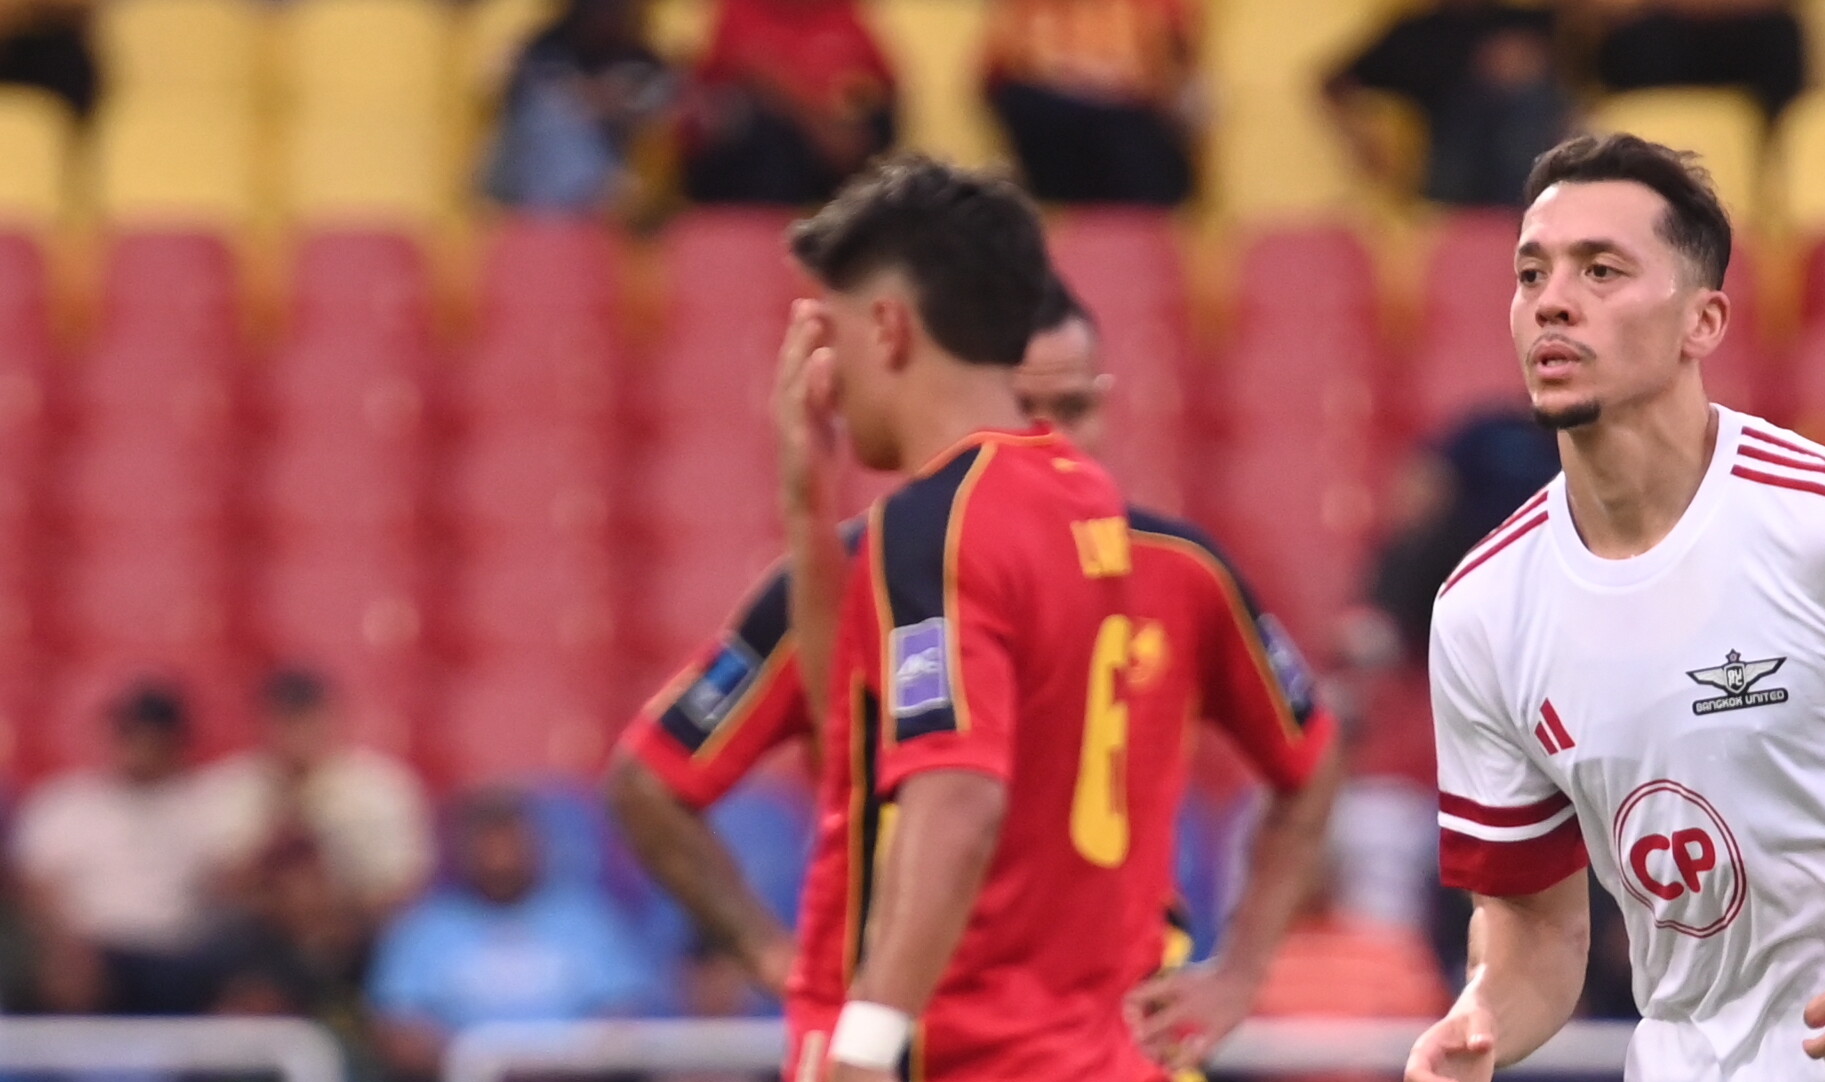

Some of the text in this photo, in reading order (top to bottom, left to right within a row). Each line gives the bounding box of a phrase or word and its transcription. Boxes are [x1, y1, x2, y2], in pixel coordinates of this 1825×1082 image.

[1695, 690, 1785, 713] BANGKOK UNITED
[1630, 827, 1716, 901] CP
